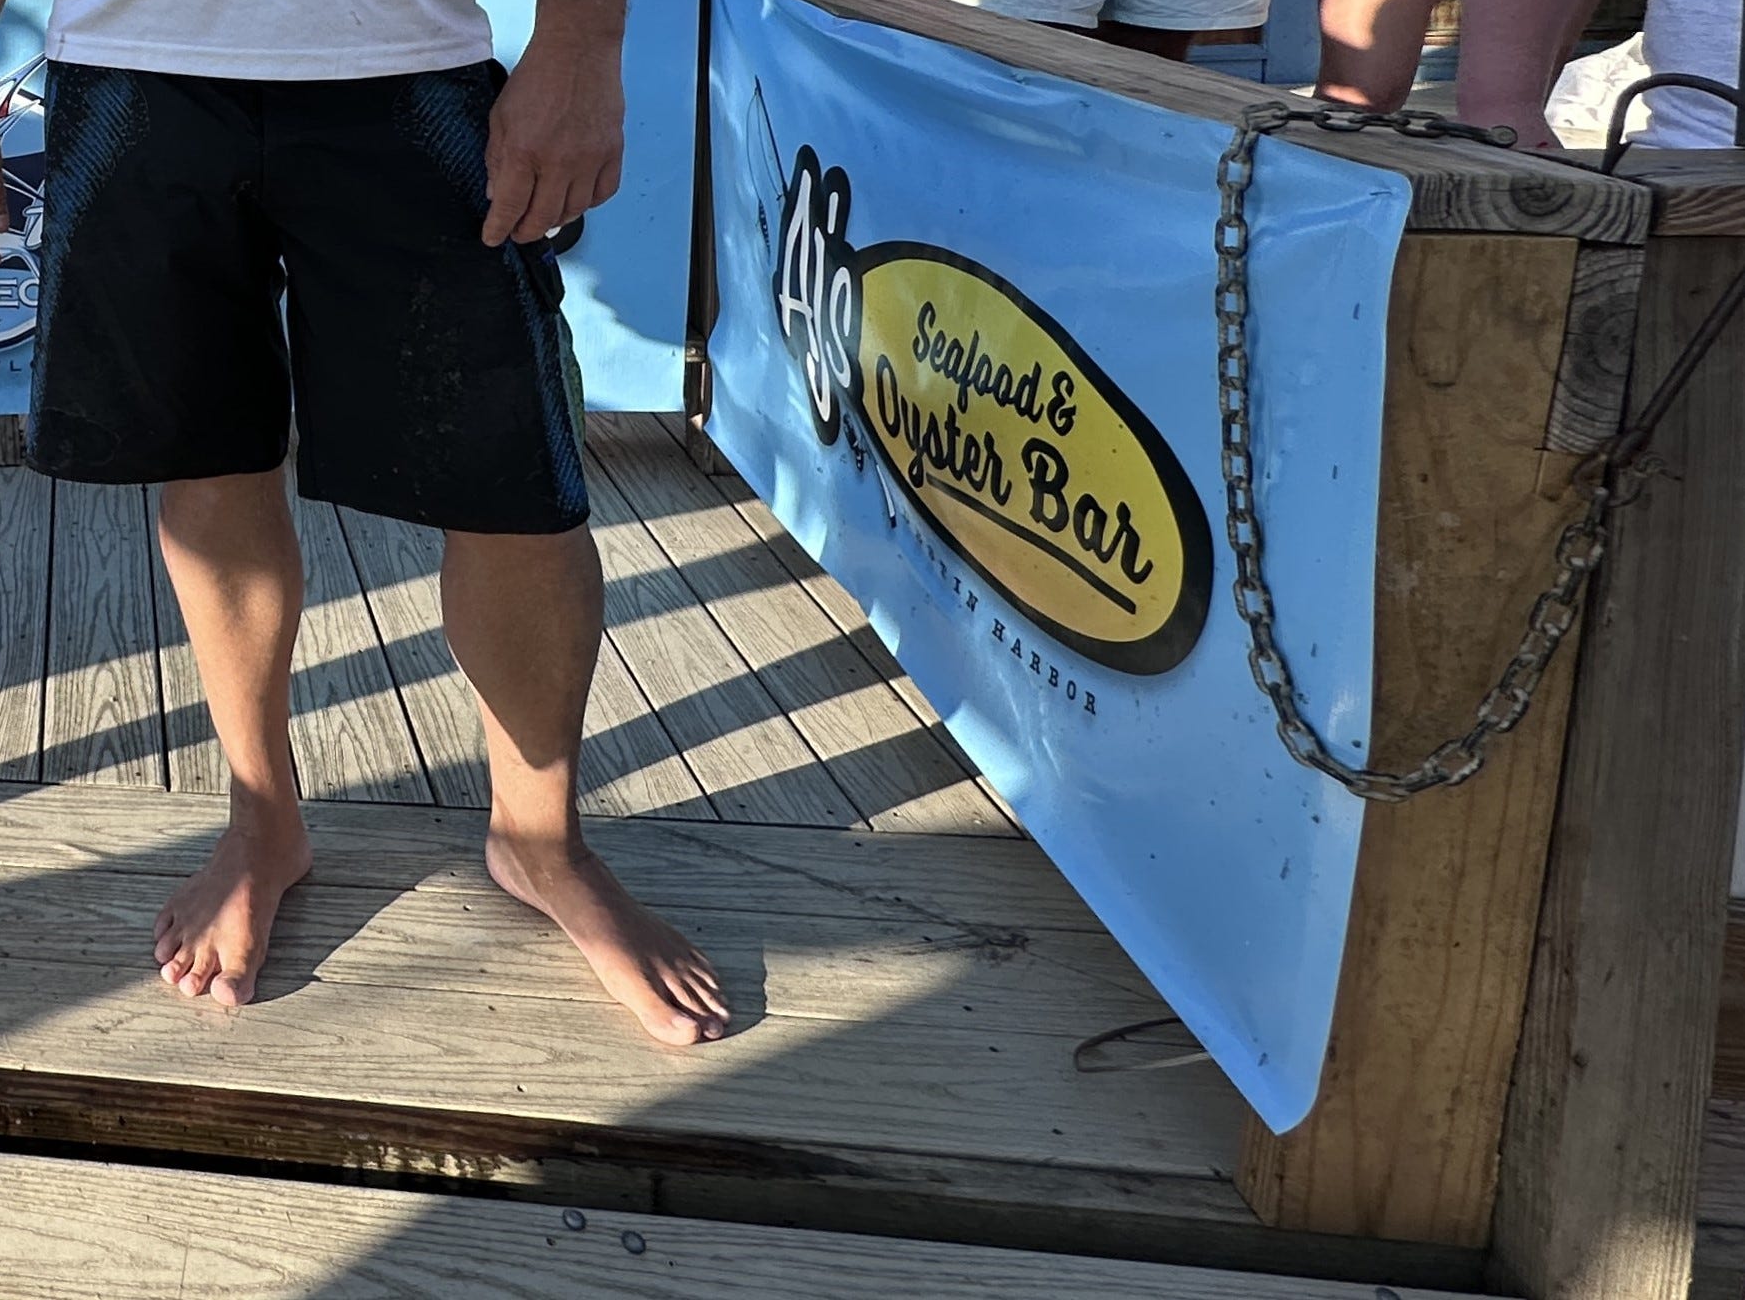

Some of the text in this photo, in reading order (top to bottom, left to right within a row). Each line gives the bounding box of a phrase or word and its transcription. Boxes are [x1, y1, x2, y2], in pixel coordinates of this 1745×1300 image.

[913, 301, 1077, 436] Seafood &
[875, 355, 1153, 584] Oyster Bar
[992, 618, 1098, 716] HARBOR
